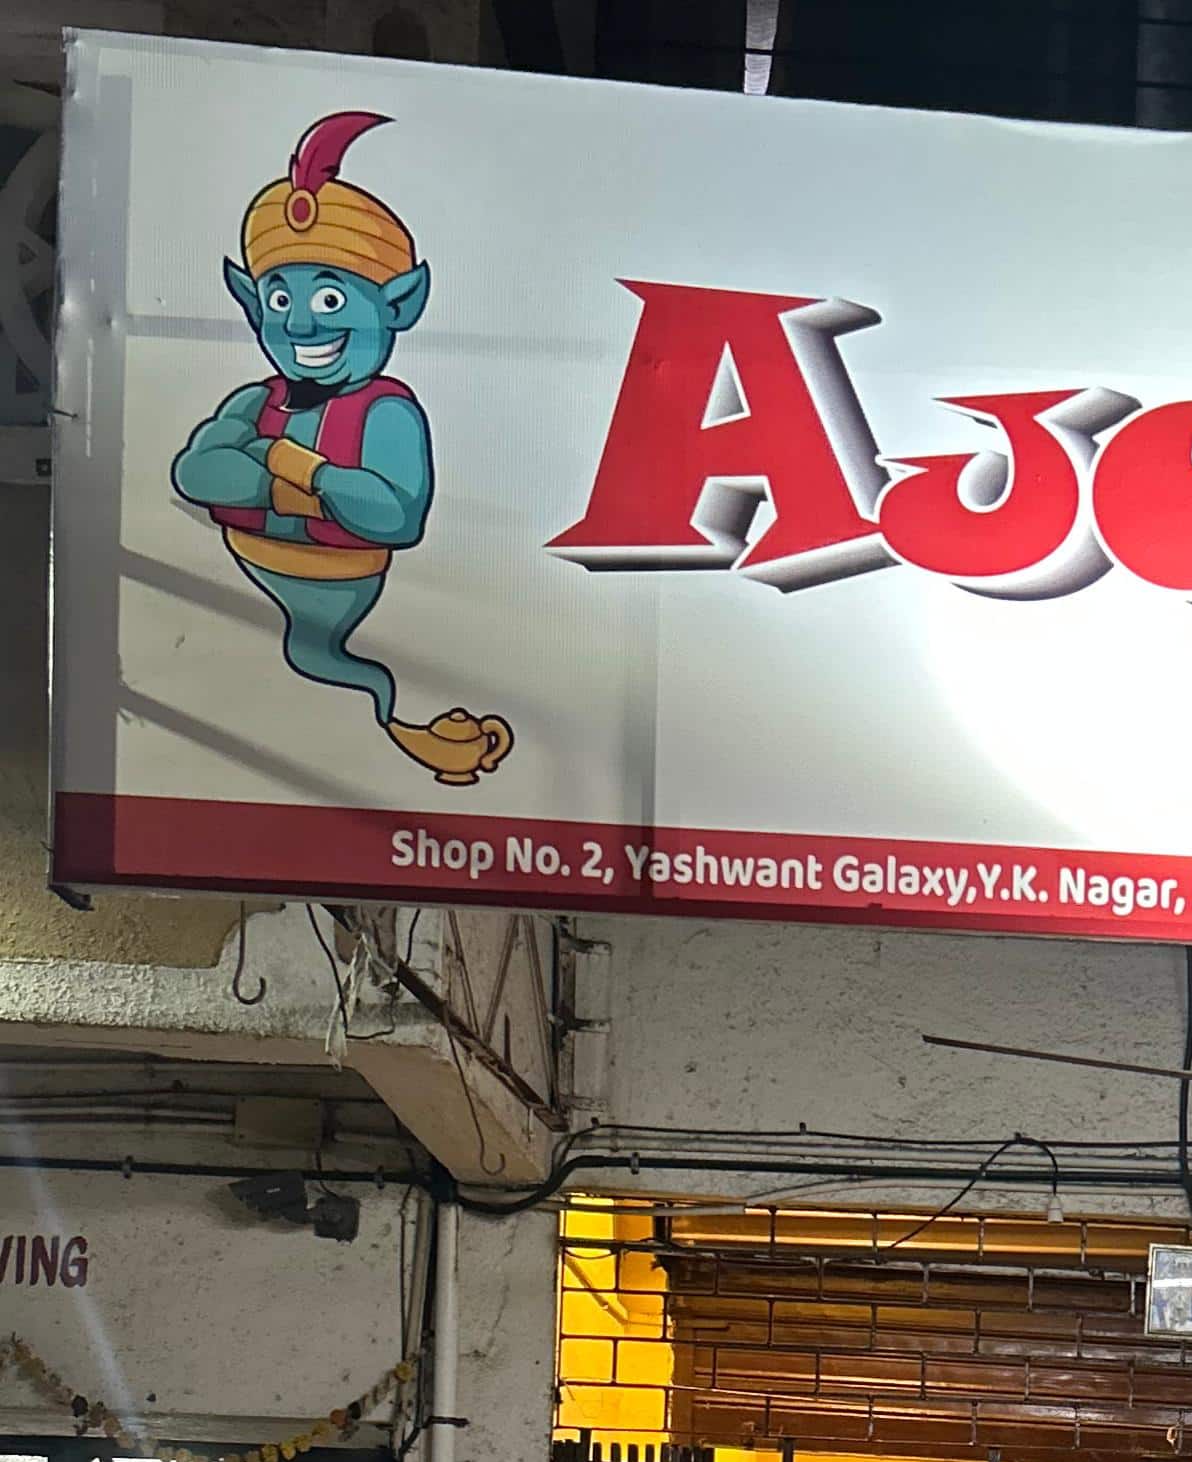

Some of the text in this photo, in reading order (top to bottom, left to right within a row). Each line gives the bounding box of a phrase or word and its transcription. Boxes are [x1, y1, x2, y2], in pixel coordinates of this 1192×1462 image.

[391, 829, 494, 879] Shop
[506, 836, 571, 877] No.
[582, 841, 614, 886] 2,
[624, 844, 822, 890] Yashwant
[1059, 867, 1185, 916] Nagar,
